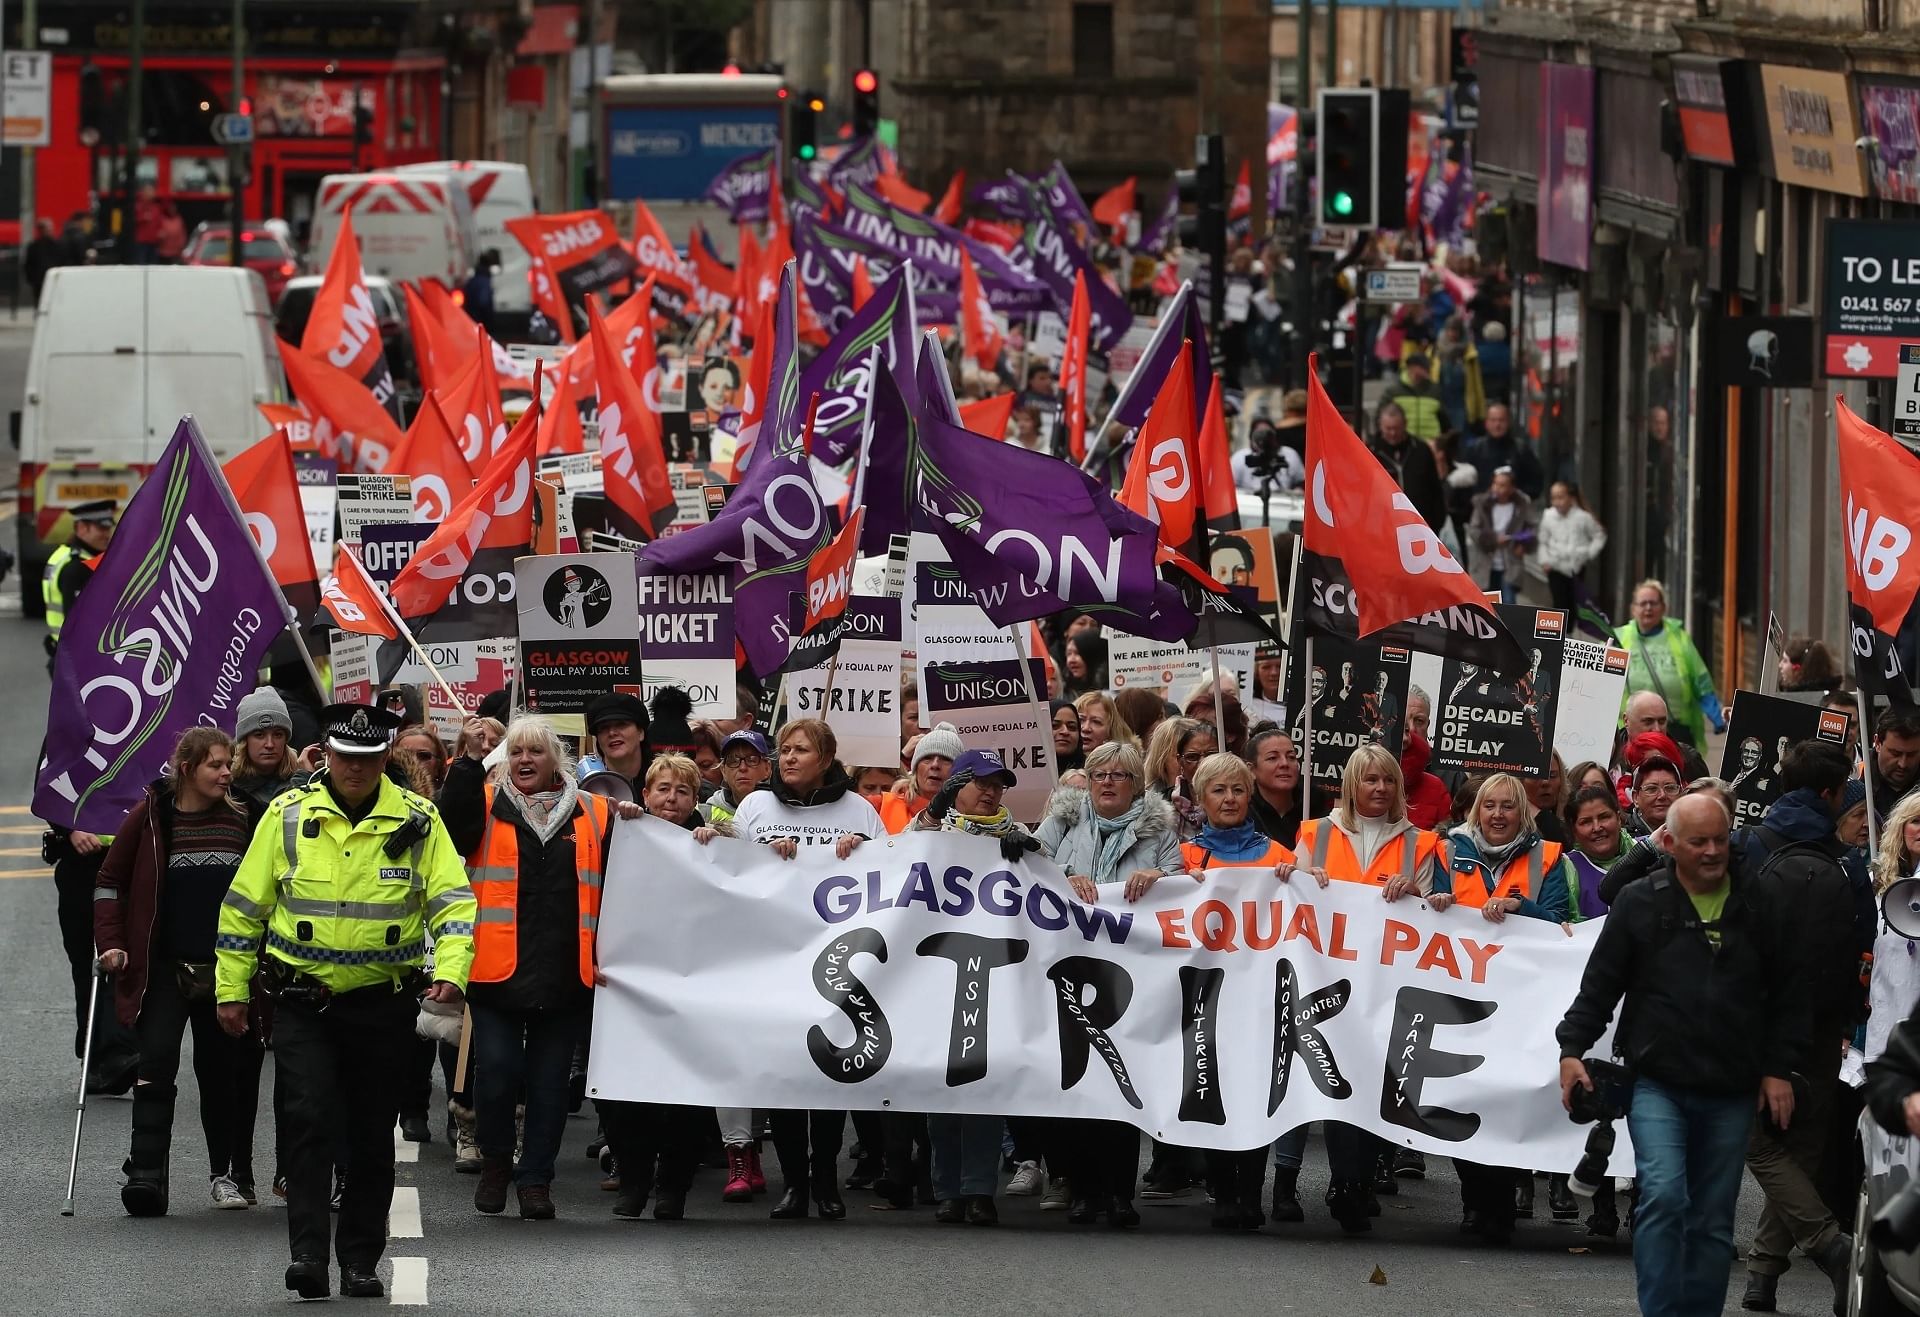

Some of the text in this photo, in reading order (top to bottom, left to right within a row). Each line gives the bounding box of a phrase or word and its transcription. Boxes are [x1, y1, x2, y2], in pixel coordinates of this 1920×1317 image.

[9, 56, 41, 79] ET
[1842, 256, 1920, 284] TO LE
[1841, 296, 1912, 312] 0141 567
[296, 469, 329, 483] NISON
[360, 476, 392, 484] GLASGOW
[361, 483, 393, 491] WOMEN'S
[361, 491, 394, 500] STRIKE
[639, 574, 733, 605] FFICIAL
[933, 580, 975, 598] UNI
[844, 613, 884, 633] SON
[1539, 619, 1559, 628] GMB
[924, 636, 971, 644] GLASGOW
[974, 636, 1004, 644] EQUAL
[1562, 640, 1606, 654] GLASGOW
[403, 647, 459, 666] NISON
[477, 645, 496, 653] KIDS
[1113, 652, 1128, 661] WE
[1130, 650, 1149, 659] ARE
[1151, 647, 1184, 657] WORTH
[1562, 648, 1604, 662] WOMEN'S
[529, 650, 629, 666] GLASGOW
[1561, 657, 1603, 672] STRIKE
[1607, 656, 1625, 666] GMB
[531, 666, 630, 676] EQUAL PAY JUSTICE
[846, 663, 875, 672] EQUAL
[877, 664, 893, 672] PAY
[1115, 661, 1200, 674] www.gmbscotland.org
[335, 685, 361, 704] WOMEN
[944, 678, 1028, 702] UNISON
[798, 686, 893, 714] STRIKE
[1445, 704, 1524, 726] DECADE
[957, 724, 990, 735] SGOW
[992, 722, 1024, 732] EQUAL
[1442, 722, 1468, 736] OF
[1823, 720, 1842, 731] GMB
[1441, 737, 1504, 757] DELAY
[998, 745, 1047, 771] IKE
[1439, 757, 1539, 774] www.gmbscotland.org
[756, 824, 802, 834] GLASGOW
[803, 826, 832, 834] EQUAL
[381, 869, 410, 879] POLICE
[813, 862, 1504, 984] GLASGOW EQUAL PAY
[824, 942, 879, 1073] COMPARATORS
[962, 956, 982, 1058] NSWP
[1294, 993, 1342, 1026] CONTEXT
[806, 926, 1498, 1142] STRIKE
[1061, 976, 1130, 1087] PROTECTION
[1277, 972, 1292, 1085] WORKING
[1193, 986, 1209, 1100] INTEREST
[1300, 1033, 1340, 1087] DEMAND
[1395, 1013, 1424, 1107] PARITY
